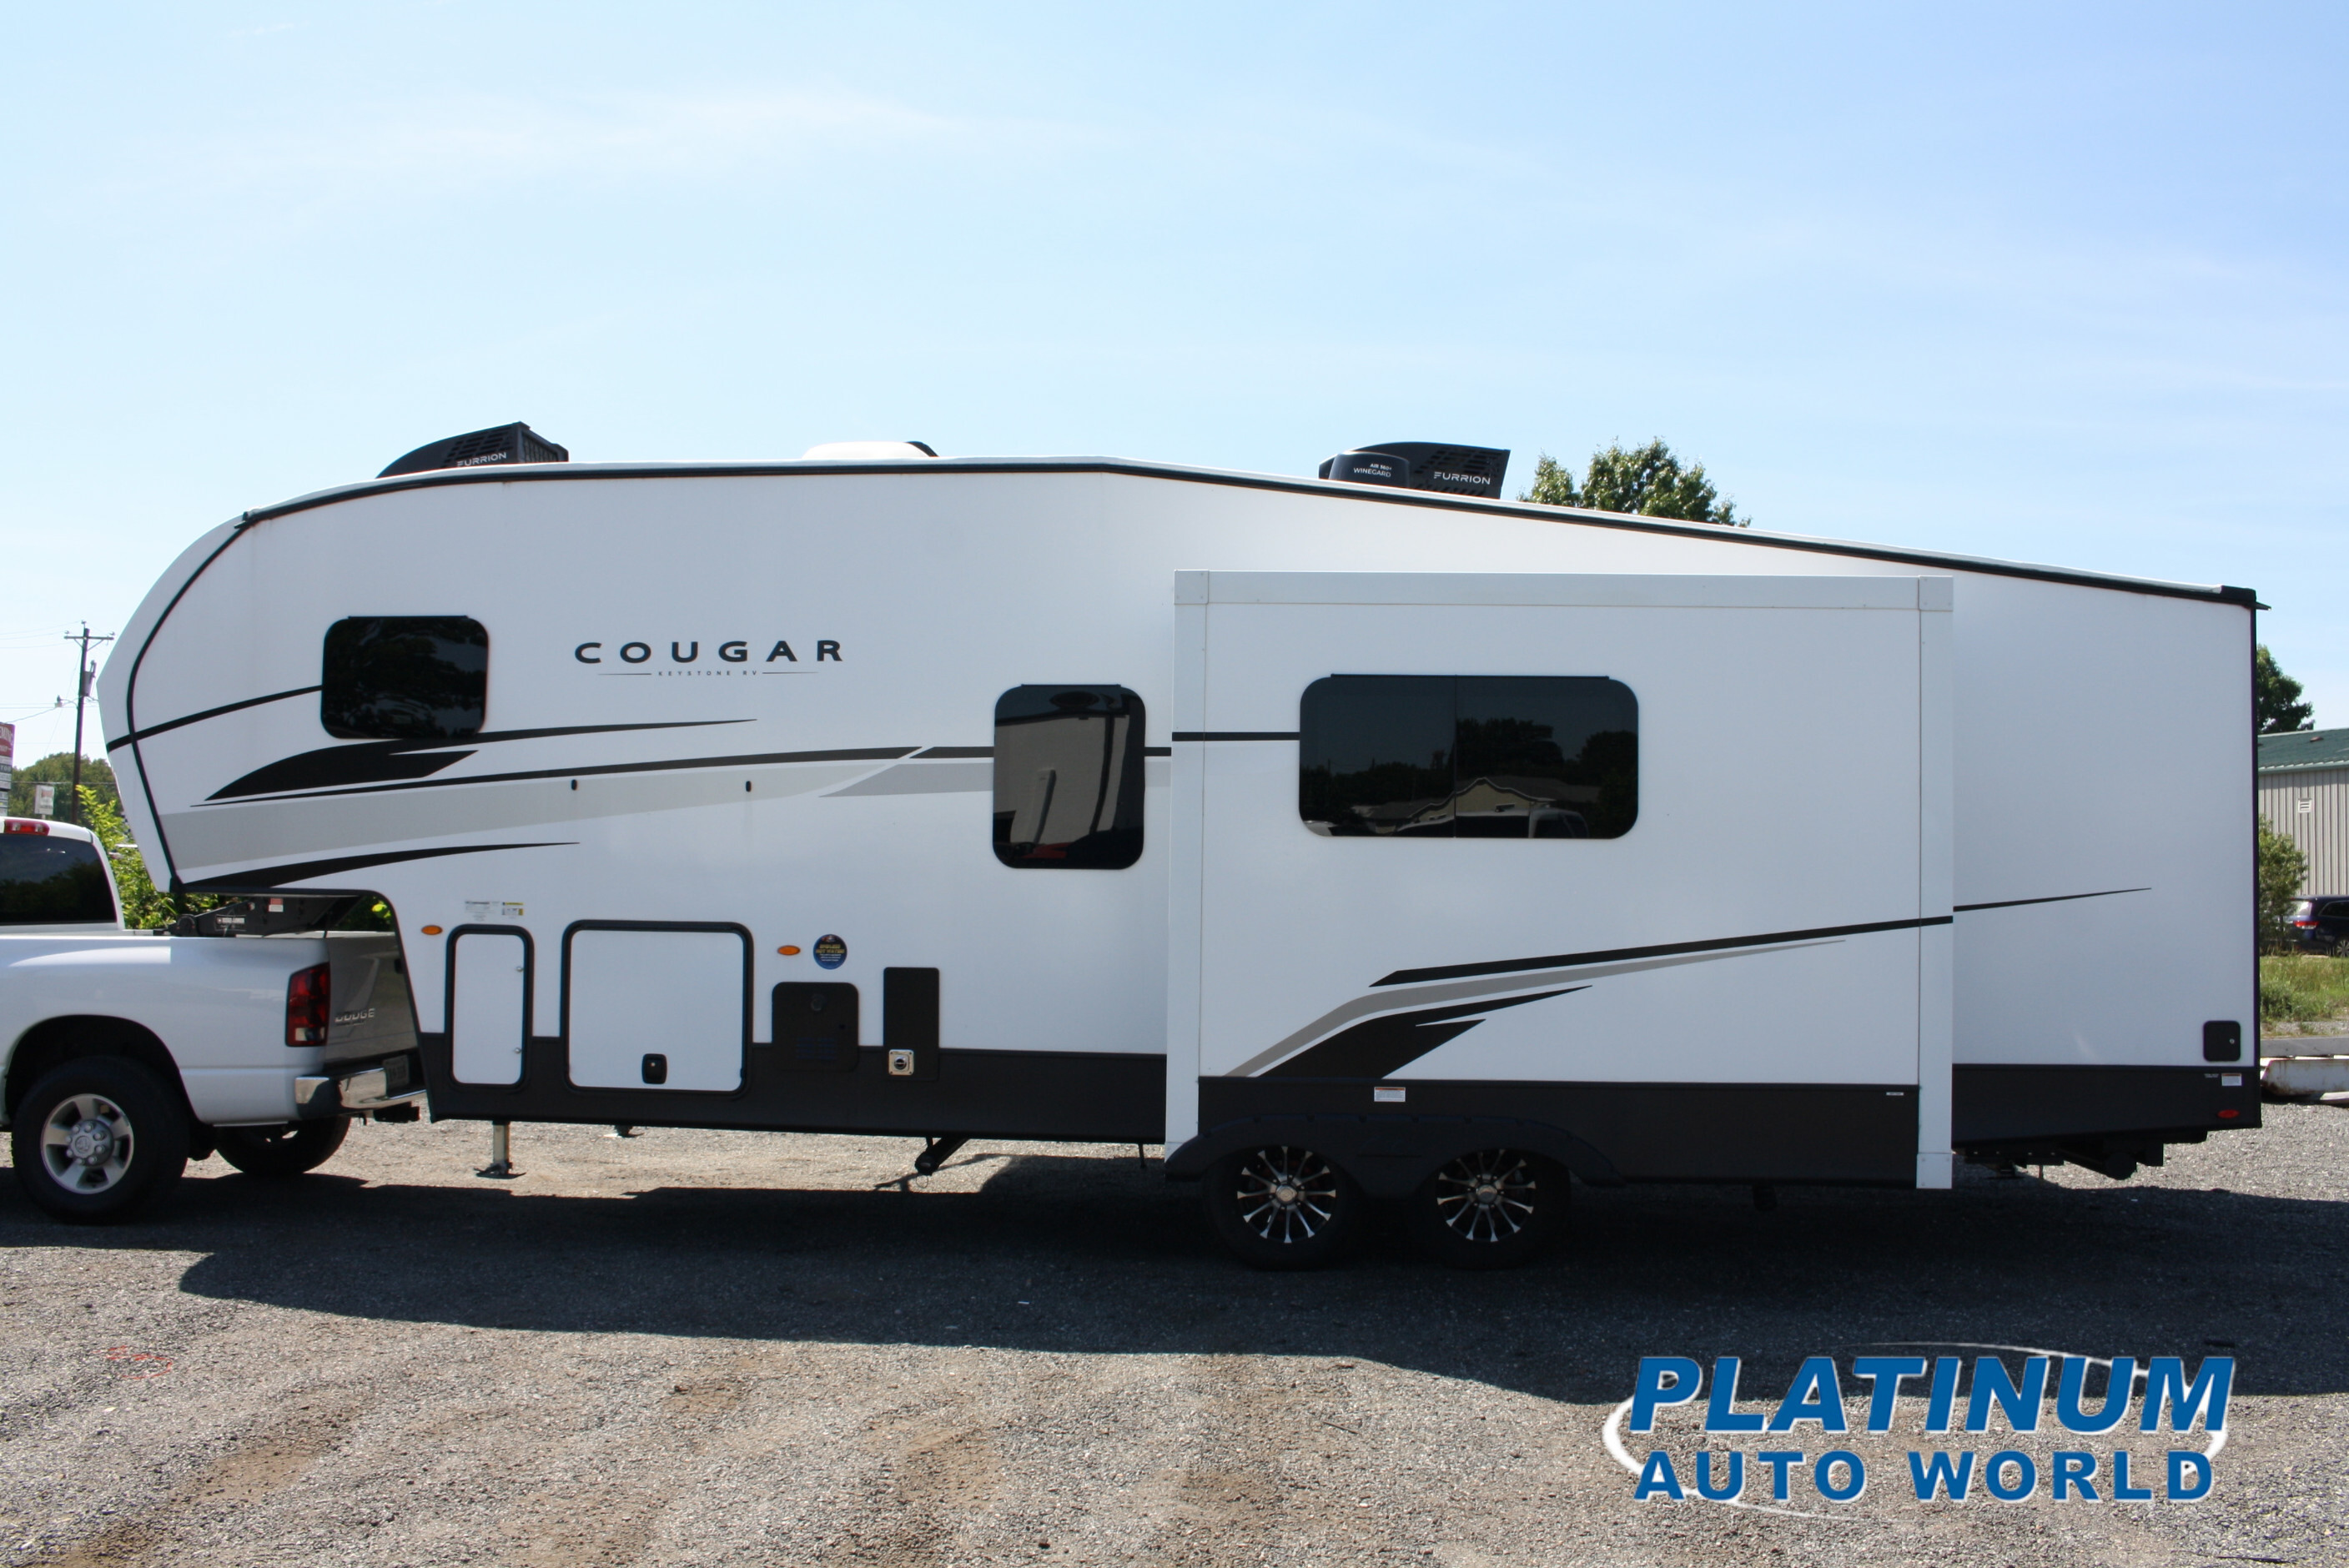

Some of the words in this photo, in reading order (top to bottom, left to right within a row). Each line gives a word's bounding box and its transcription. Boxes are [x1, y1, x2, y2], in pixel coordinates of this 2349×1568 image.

[456, 451, 507, 467] FURRION
[1353, 467, 1391, 478] WINEGARD
[1433, 471, 1491, 485] FURRION
[574, 640, 843, 664] COUGAR
[334, 1008, 375, 1023] DODGE
